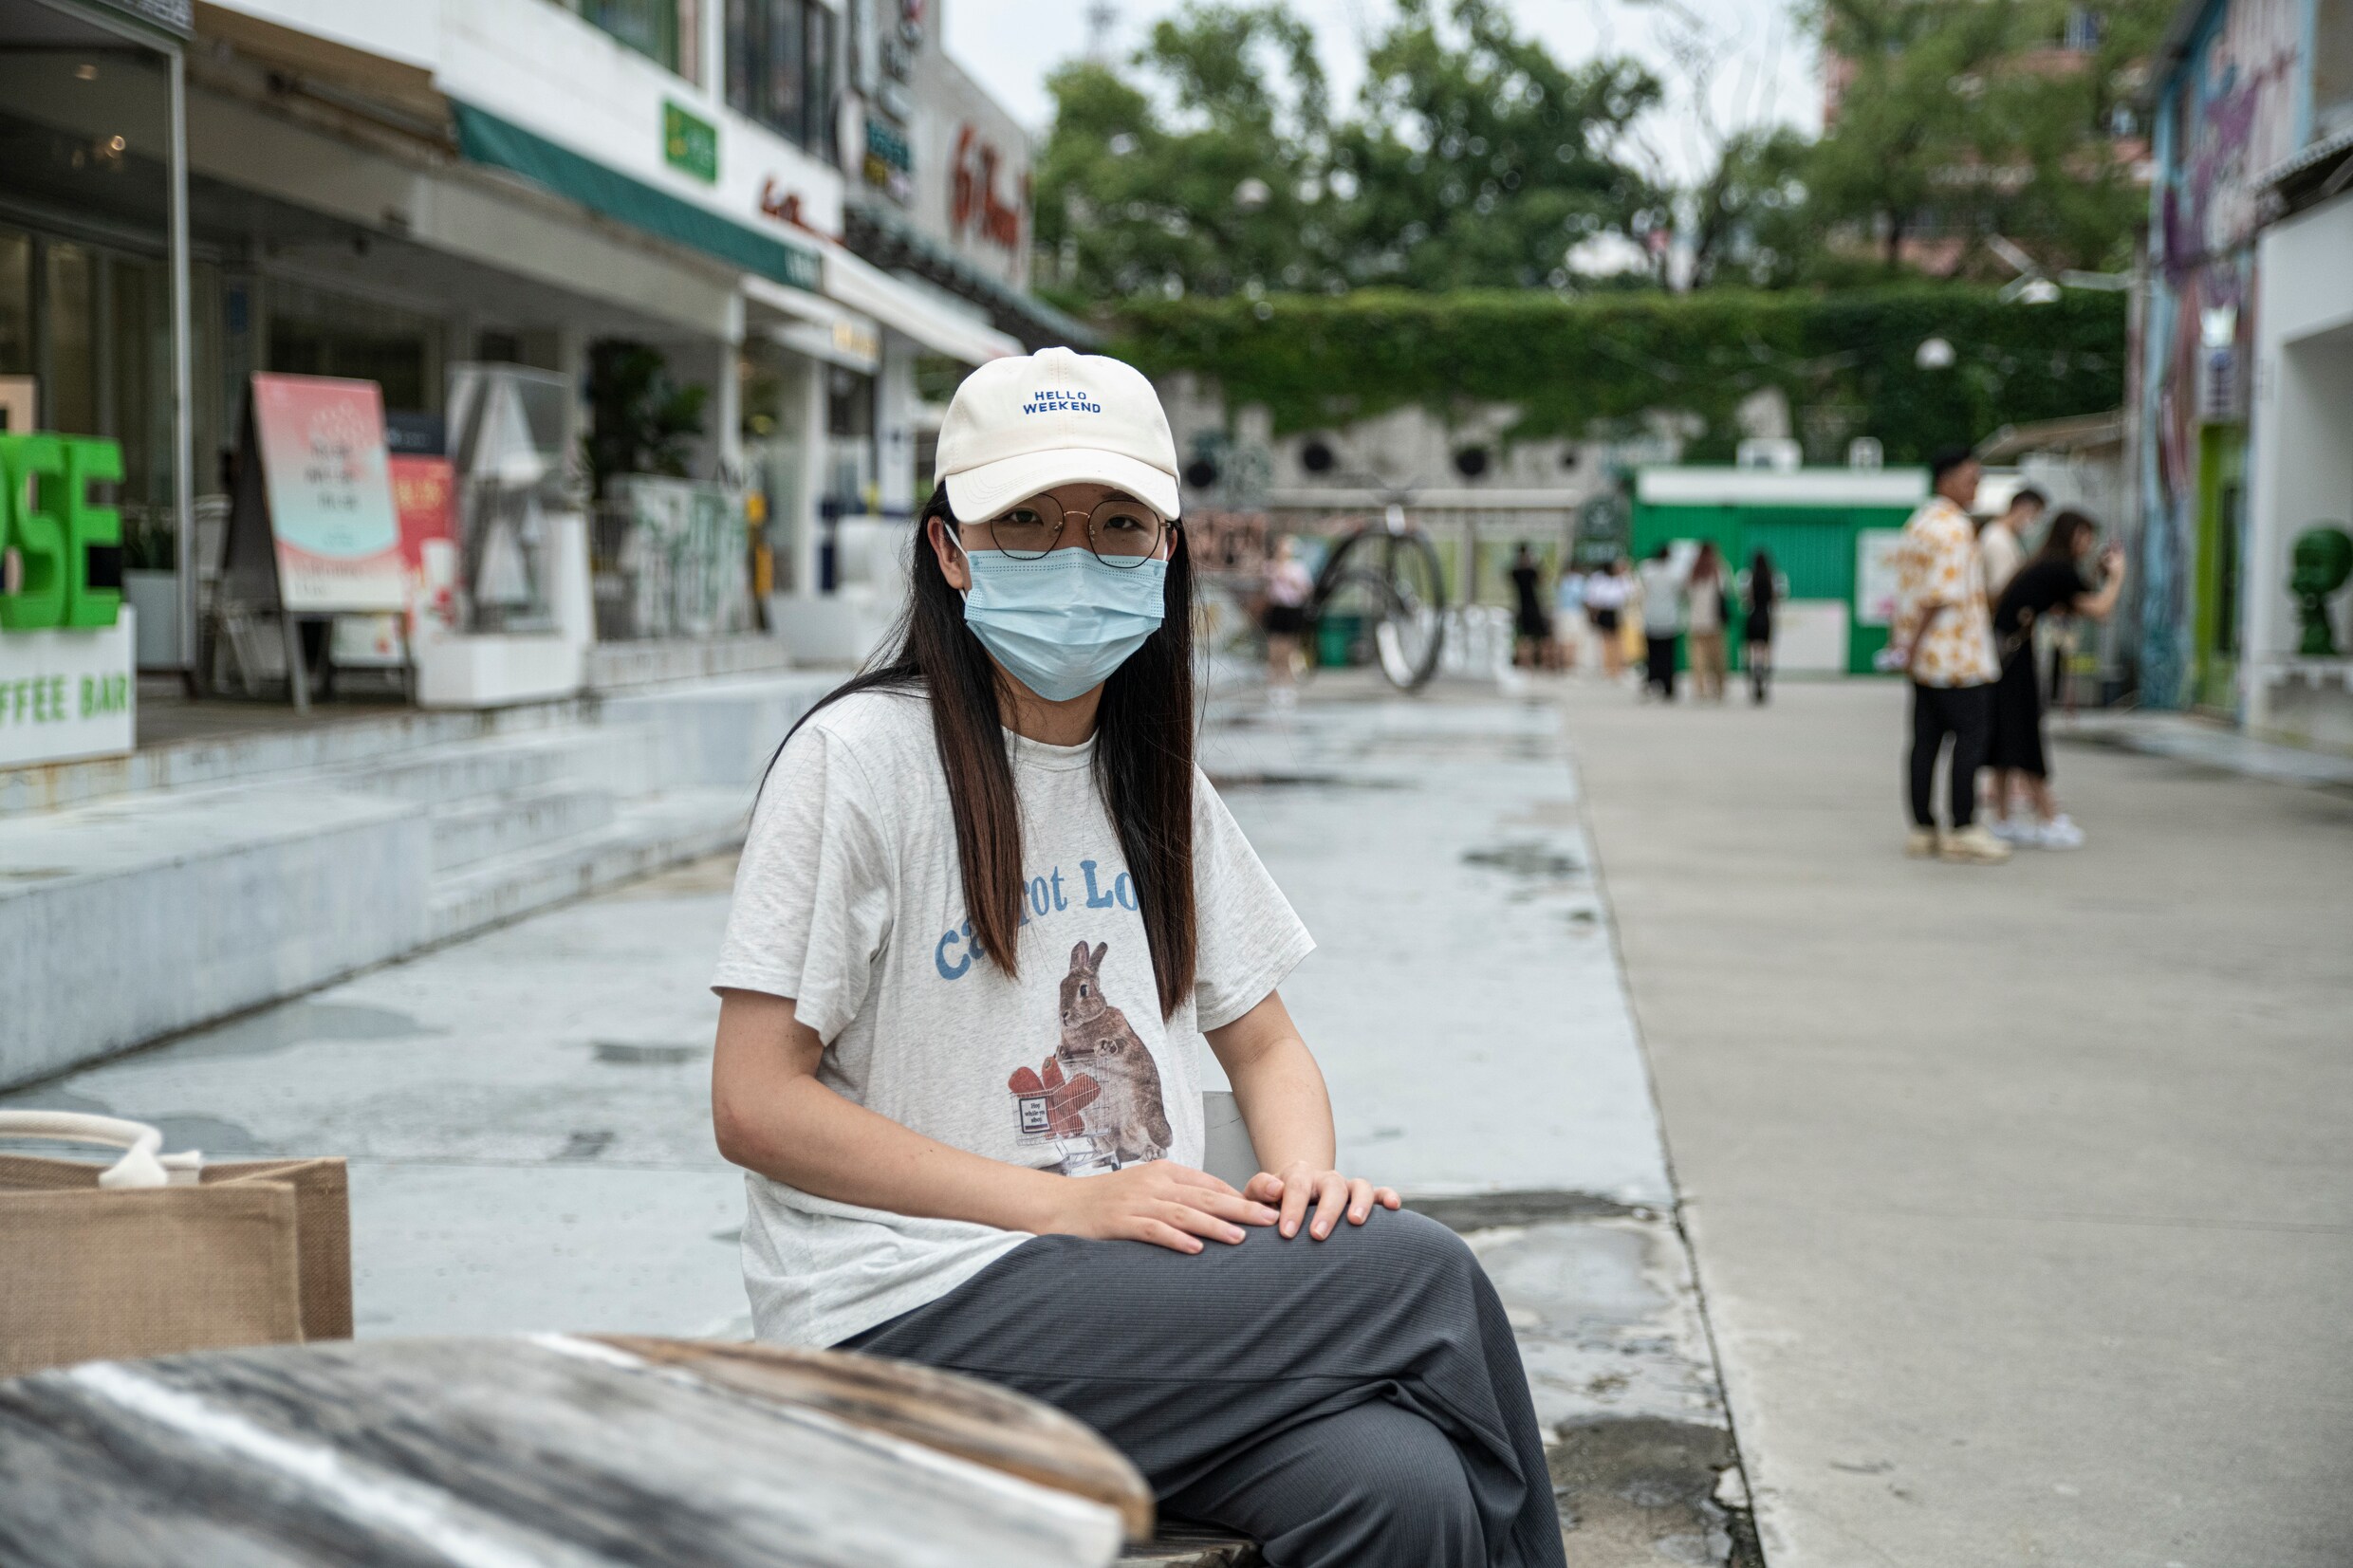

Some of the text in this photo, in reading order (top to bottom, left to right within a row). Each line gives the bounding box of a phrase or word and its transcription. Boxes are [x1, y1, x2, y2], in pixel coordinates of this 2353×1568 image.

[1023, 400, 1101, 415] WEEKEND
[1034, 390, 1087, 400] HELLO
[0, 433, 125, 630] SE
[80, 672, 128, 720] BAR
